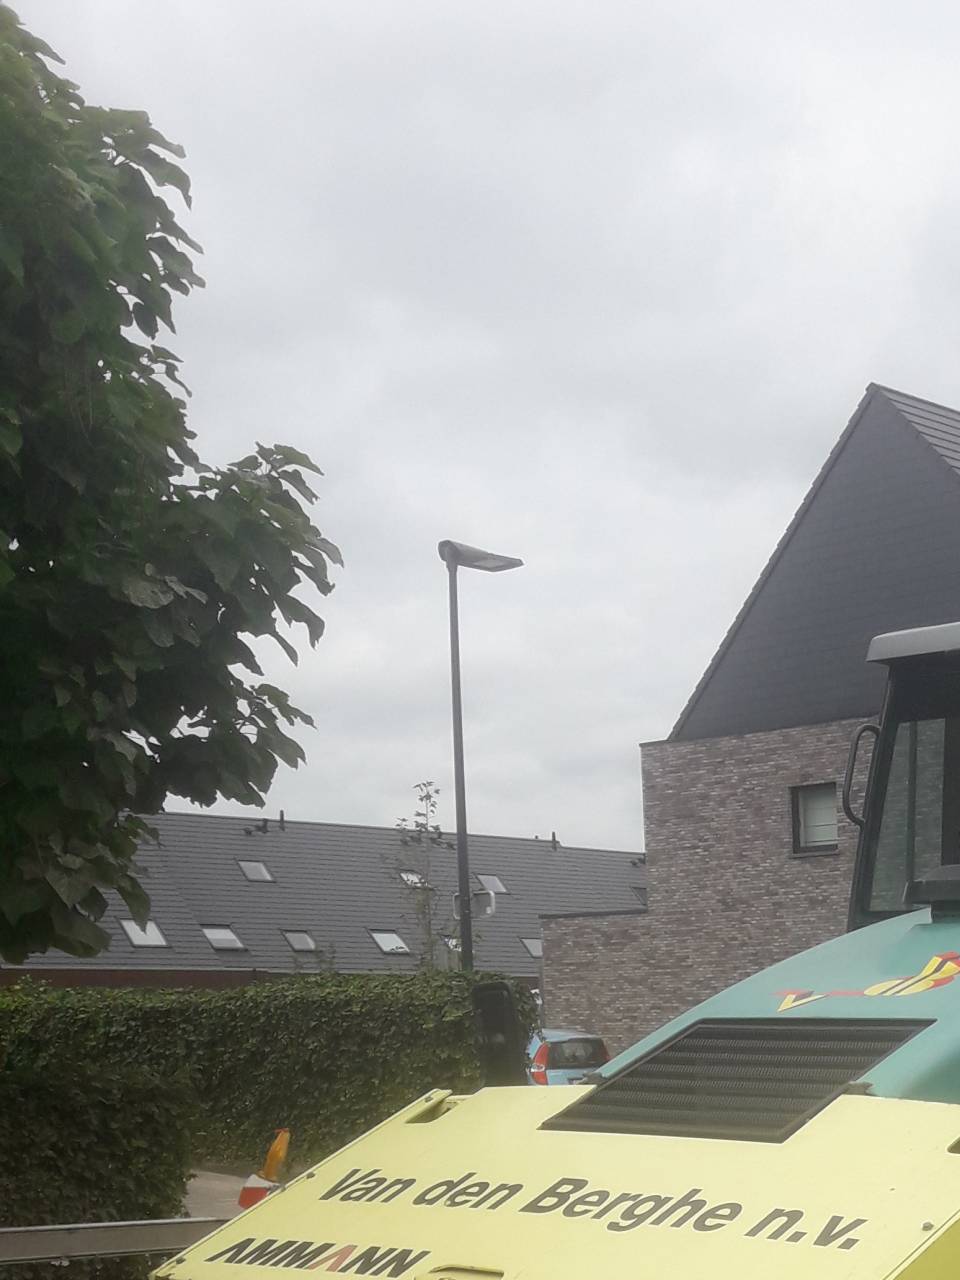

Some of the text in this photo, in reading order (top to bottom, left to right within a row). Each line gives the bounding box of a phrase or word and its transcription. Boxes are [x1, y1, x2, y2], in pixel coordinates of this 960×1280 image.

[318, 1168, 868, 1250] Van den Berghe n.v.
[204, 1237, 432, 1278] AMMANN
